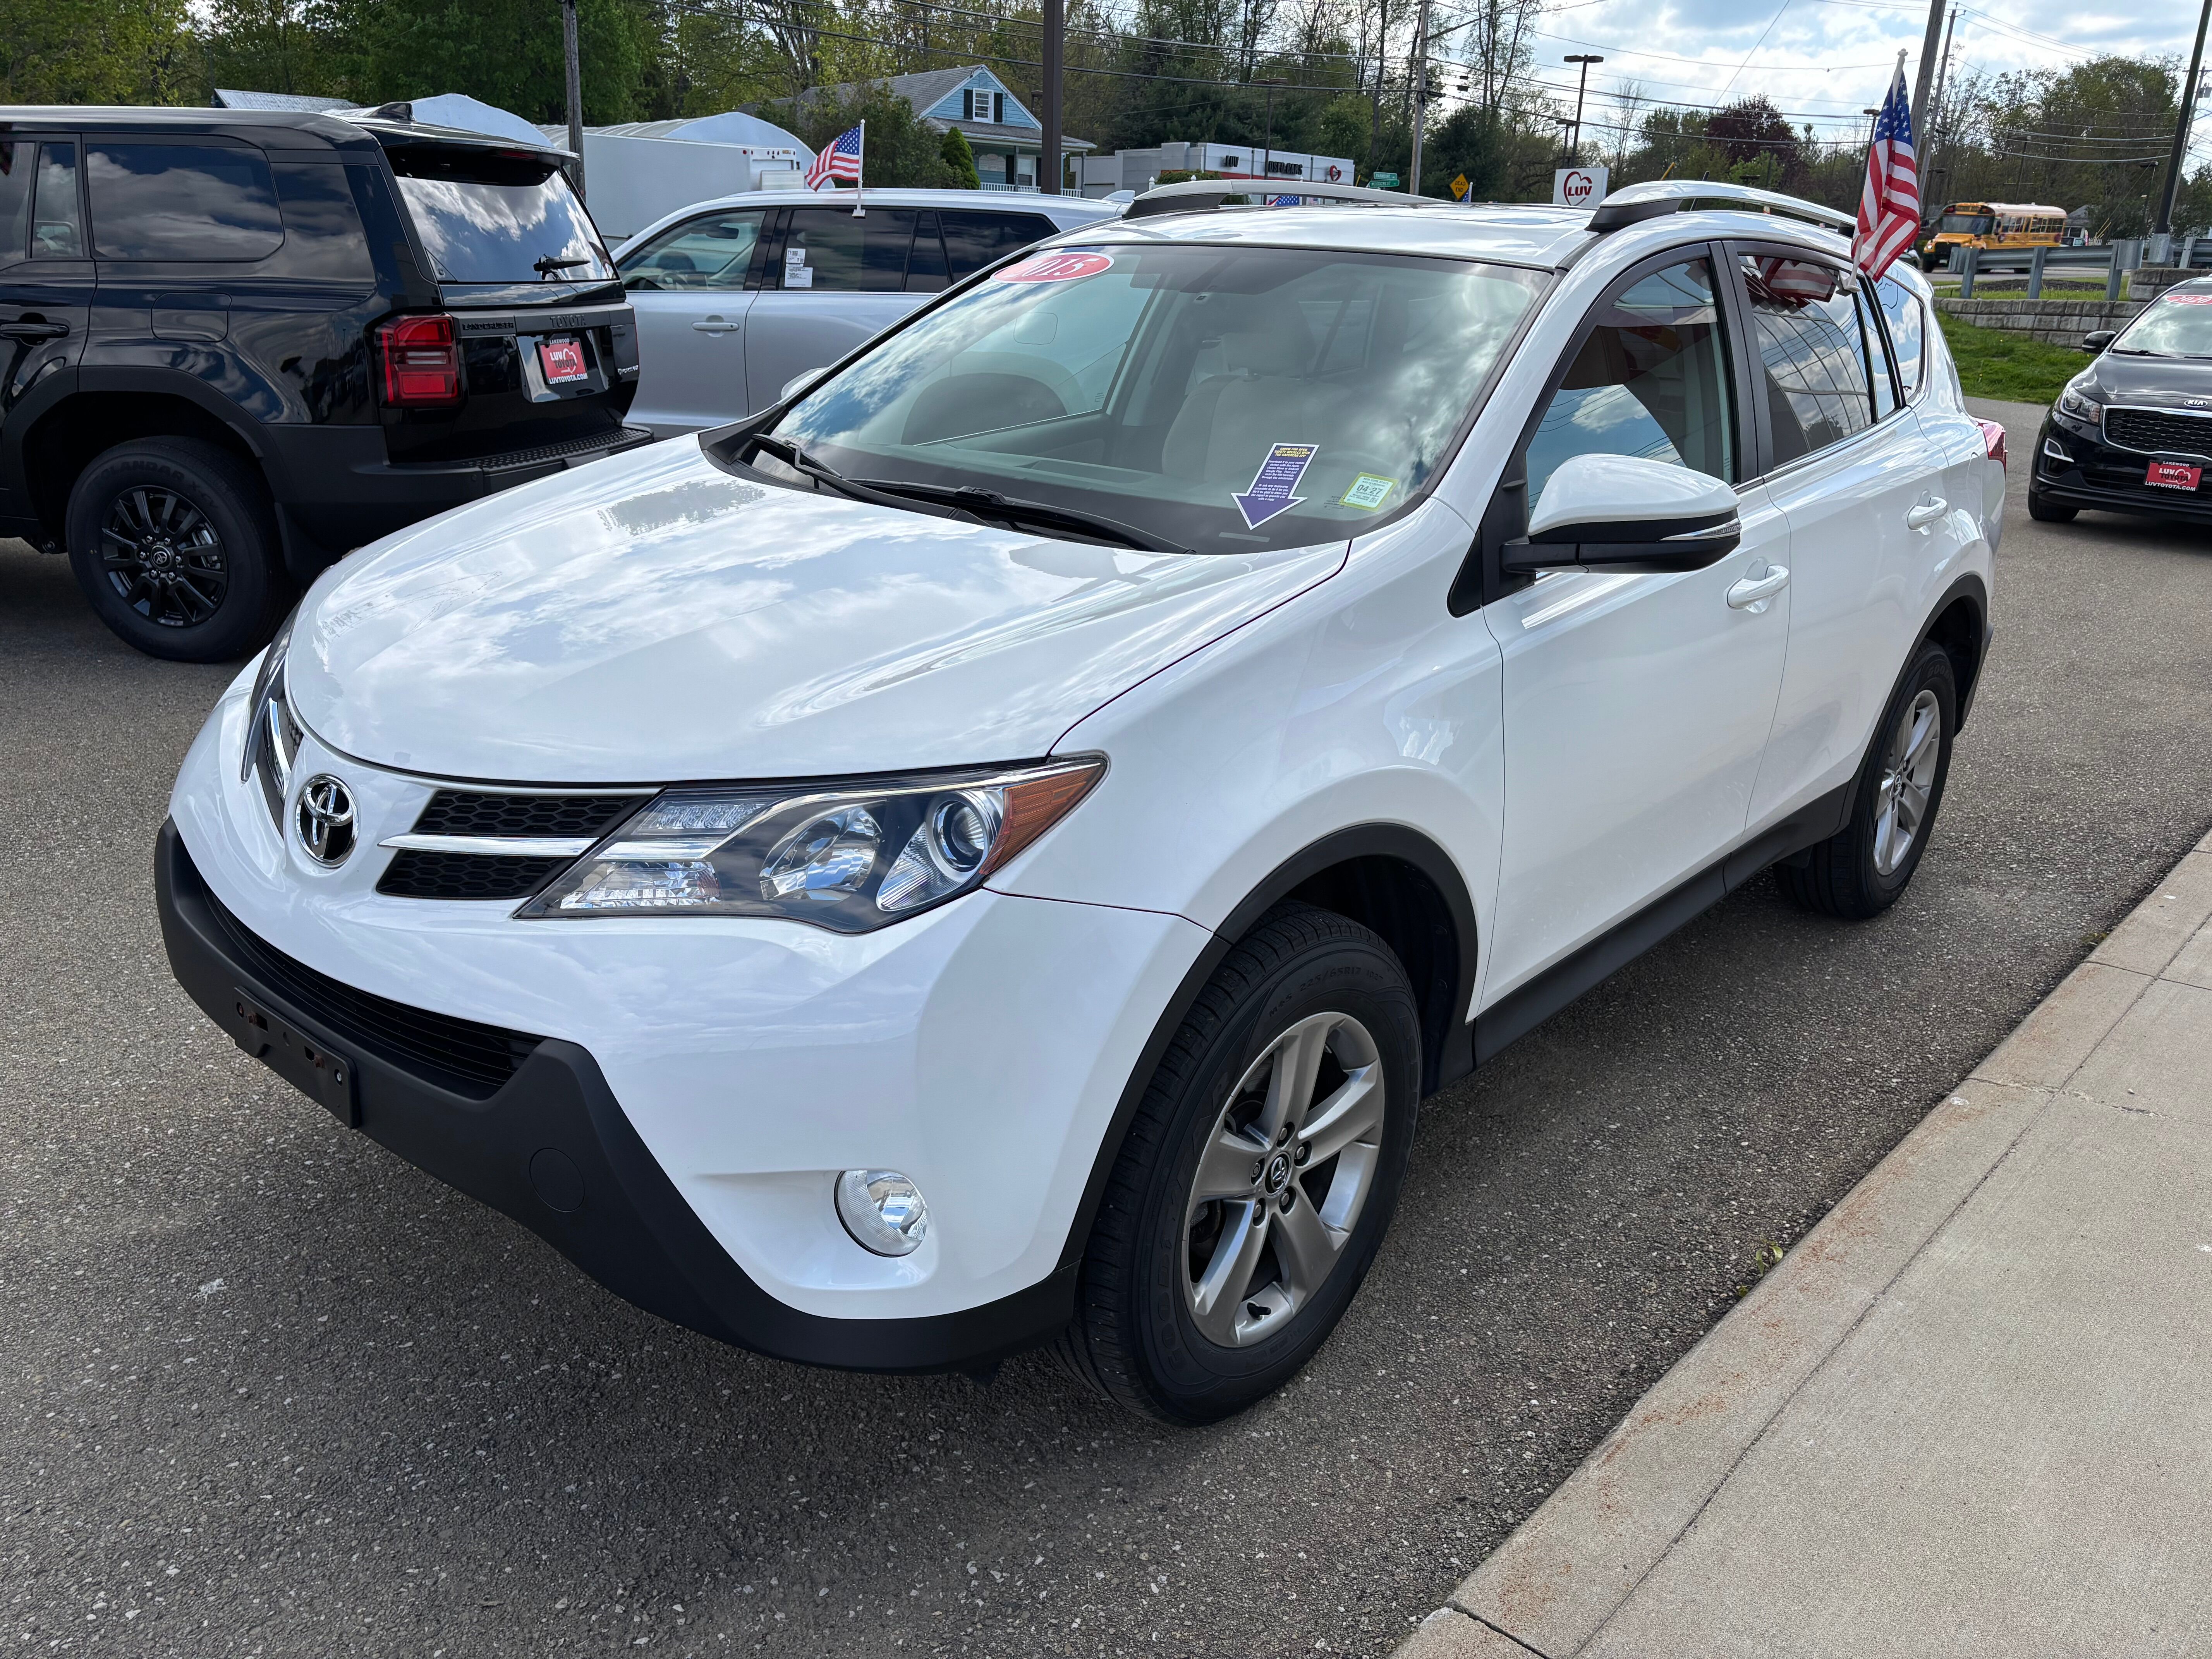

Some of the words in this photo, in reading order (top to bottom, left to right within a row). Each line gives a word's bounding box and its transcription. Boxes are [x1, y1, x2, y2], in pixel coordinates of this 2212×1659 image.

[1268, 161, 1285, 173] USED
[1286, 163, 1303, 175] CARS
[1568, 186, 1592, 196] LUV
[550, 314, 587, 328] TOYOTA
[550, 352, 563, 361] LUV
[553, 359, 577, 369] TOYOTA
[549, 373, 588, 385] LUVTOYOTA.COM
[2145, 481, 2196, 491] LUVTOYOTA.COM
[1299, 967, 1361, 992] 225/65R17
